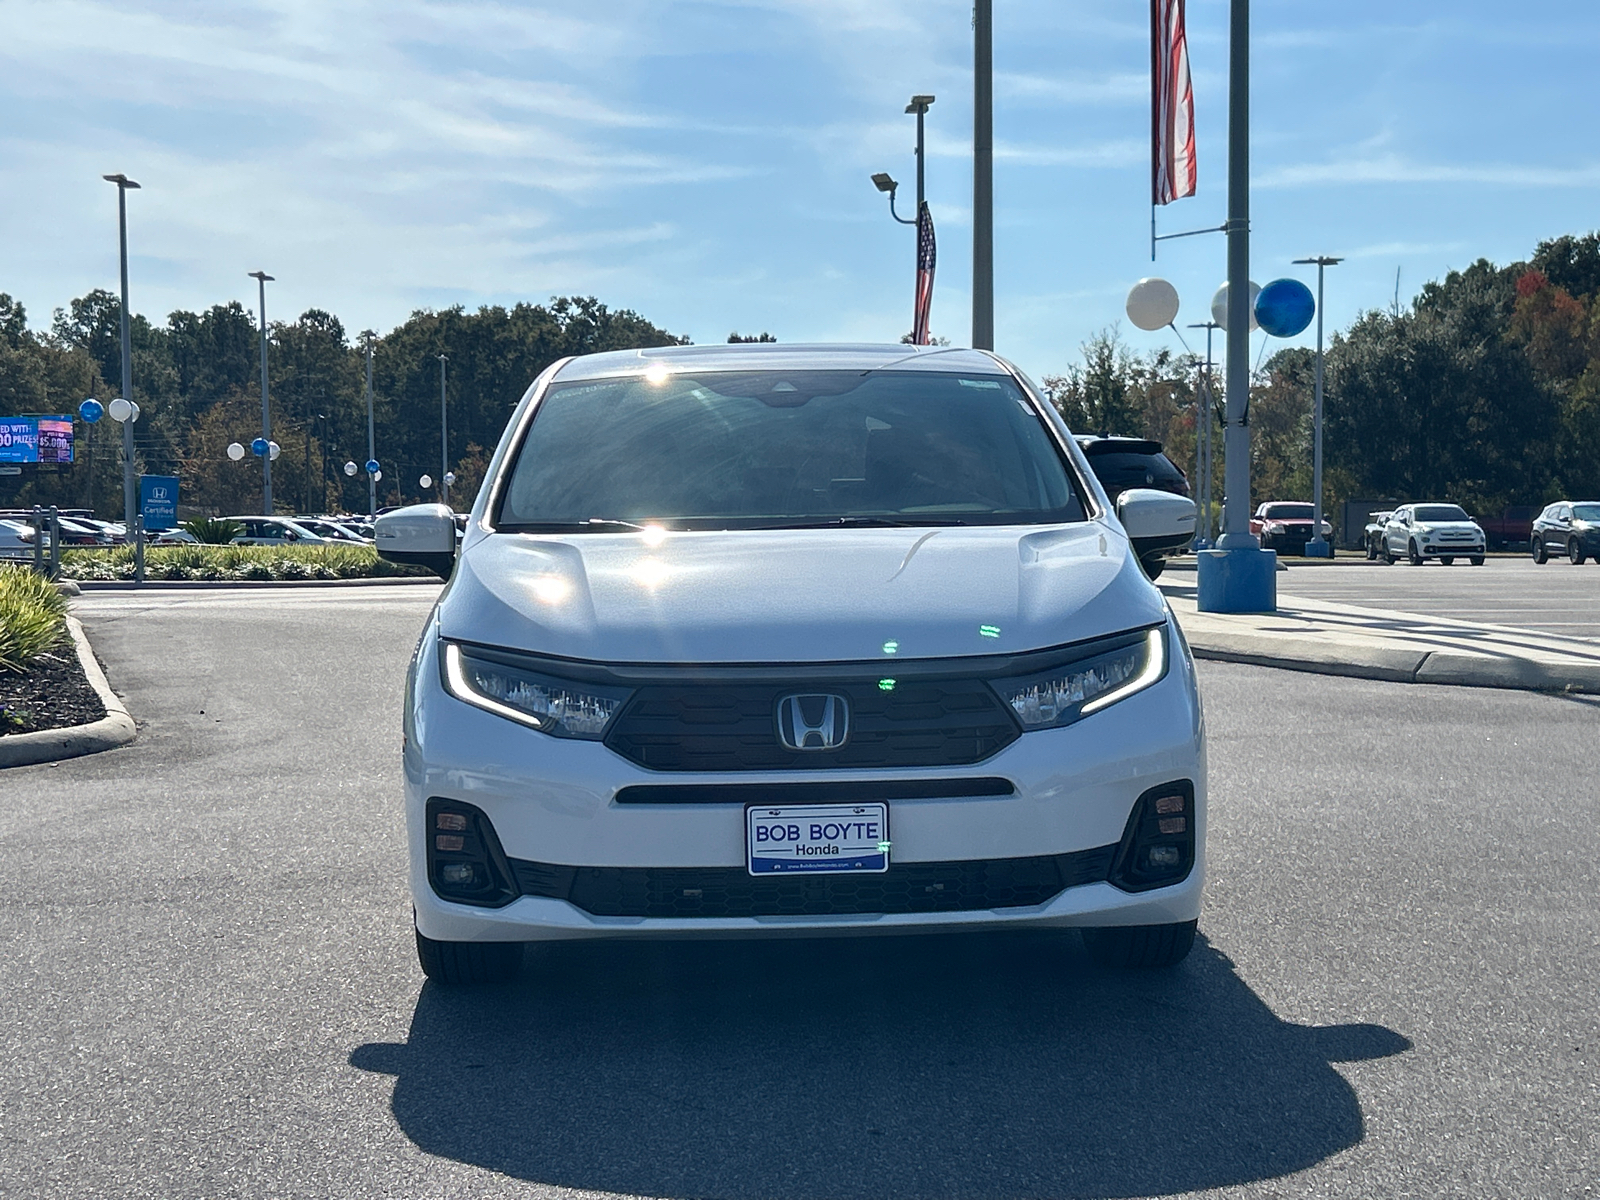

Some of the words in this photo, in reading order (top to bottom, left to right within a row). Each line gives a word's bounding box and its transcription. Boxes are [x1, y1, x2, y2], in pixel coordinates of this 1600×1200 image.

[11, 424, 32, 433] WITH
[144, 506, 174, 514] Certified
[756, 824, 801, 842] BOB
[809, 822, 879, 841] BOYTE
[795, 843, 840, 856] Honda
